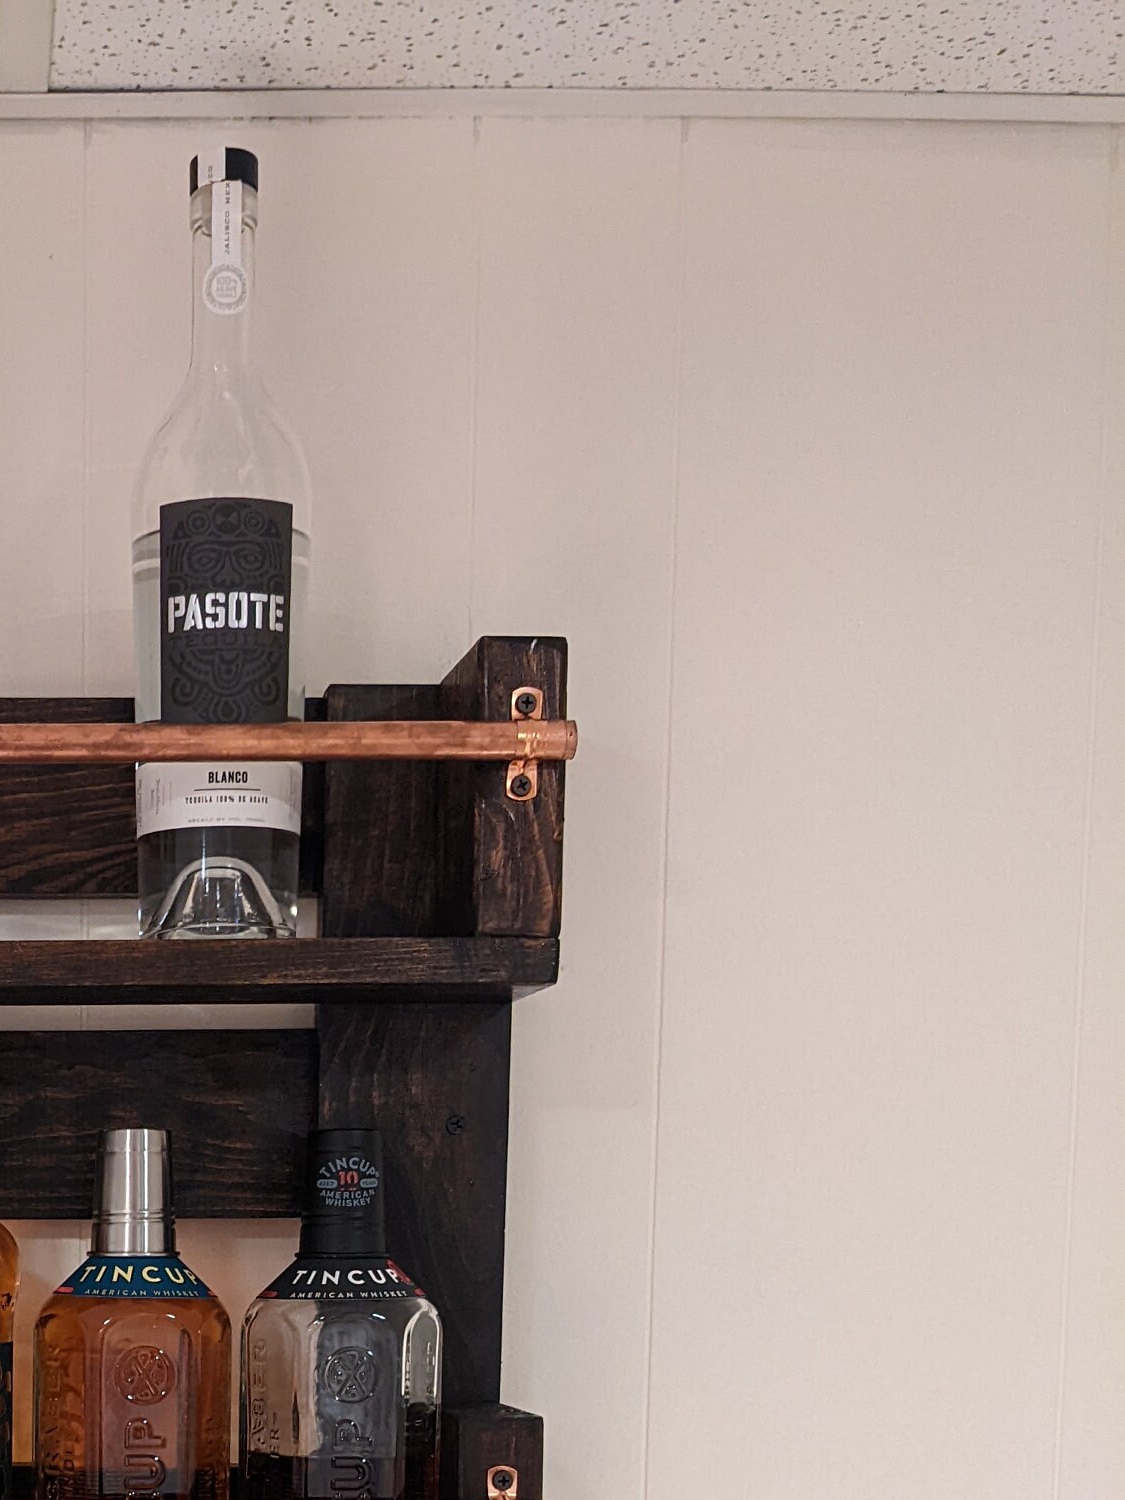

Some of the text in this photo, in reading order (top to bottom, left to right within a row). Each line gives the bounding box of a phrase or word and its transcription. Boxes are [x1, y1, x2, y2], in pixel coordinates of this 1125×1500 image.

[168, 592, 284, 633] PASOTE
[208, 771, 248, 784] BLANCO
[185, 796, 213, 804] TEQUILA
[319, 1157, 376, 1177] TINCUP
[338, 1171, 359, 1185] 10
[319, 1189, 375, 1199] AMERICAN
[325, 1197, 371, 1207] WHISKEY
[79, 1265, 198, 1285] TINCUP
[292, 1268, 400, 1285] TINCUP
[84, 1288, 147, 1296] AMERICAN
[360, 1290, 407, 1298] WHISKEY
